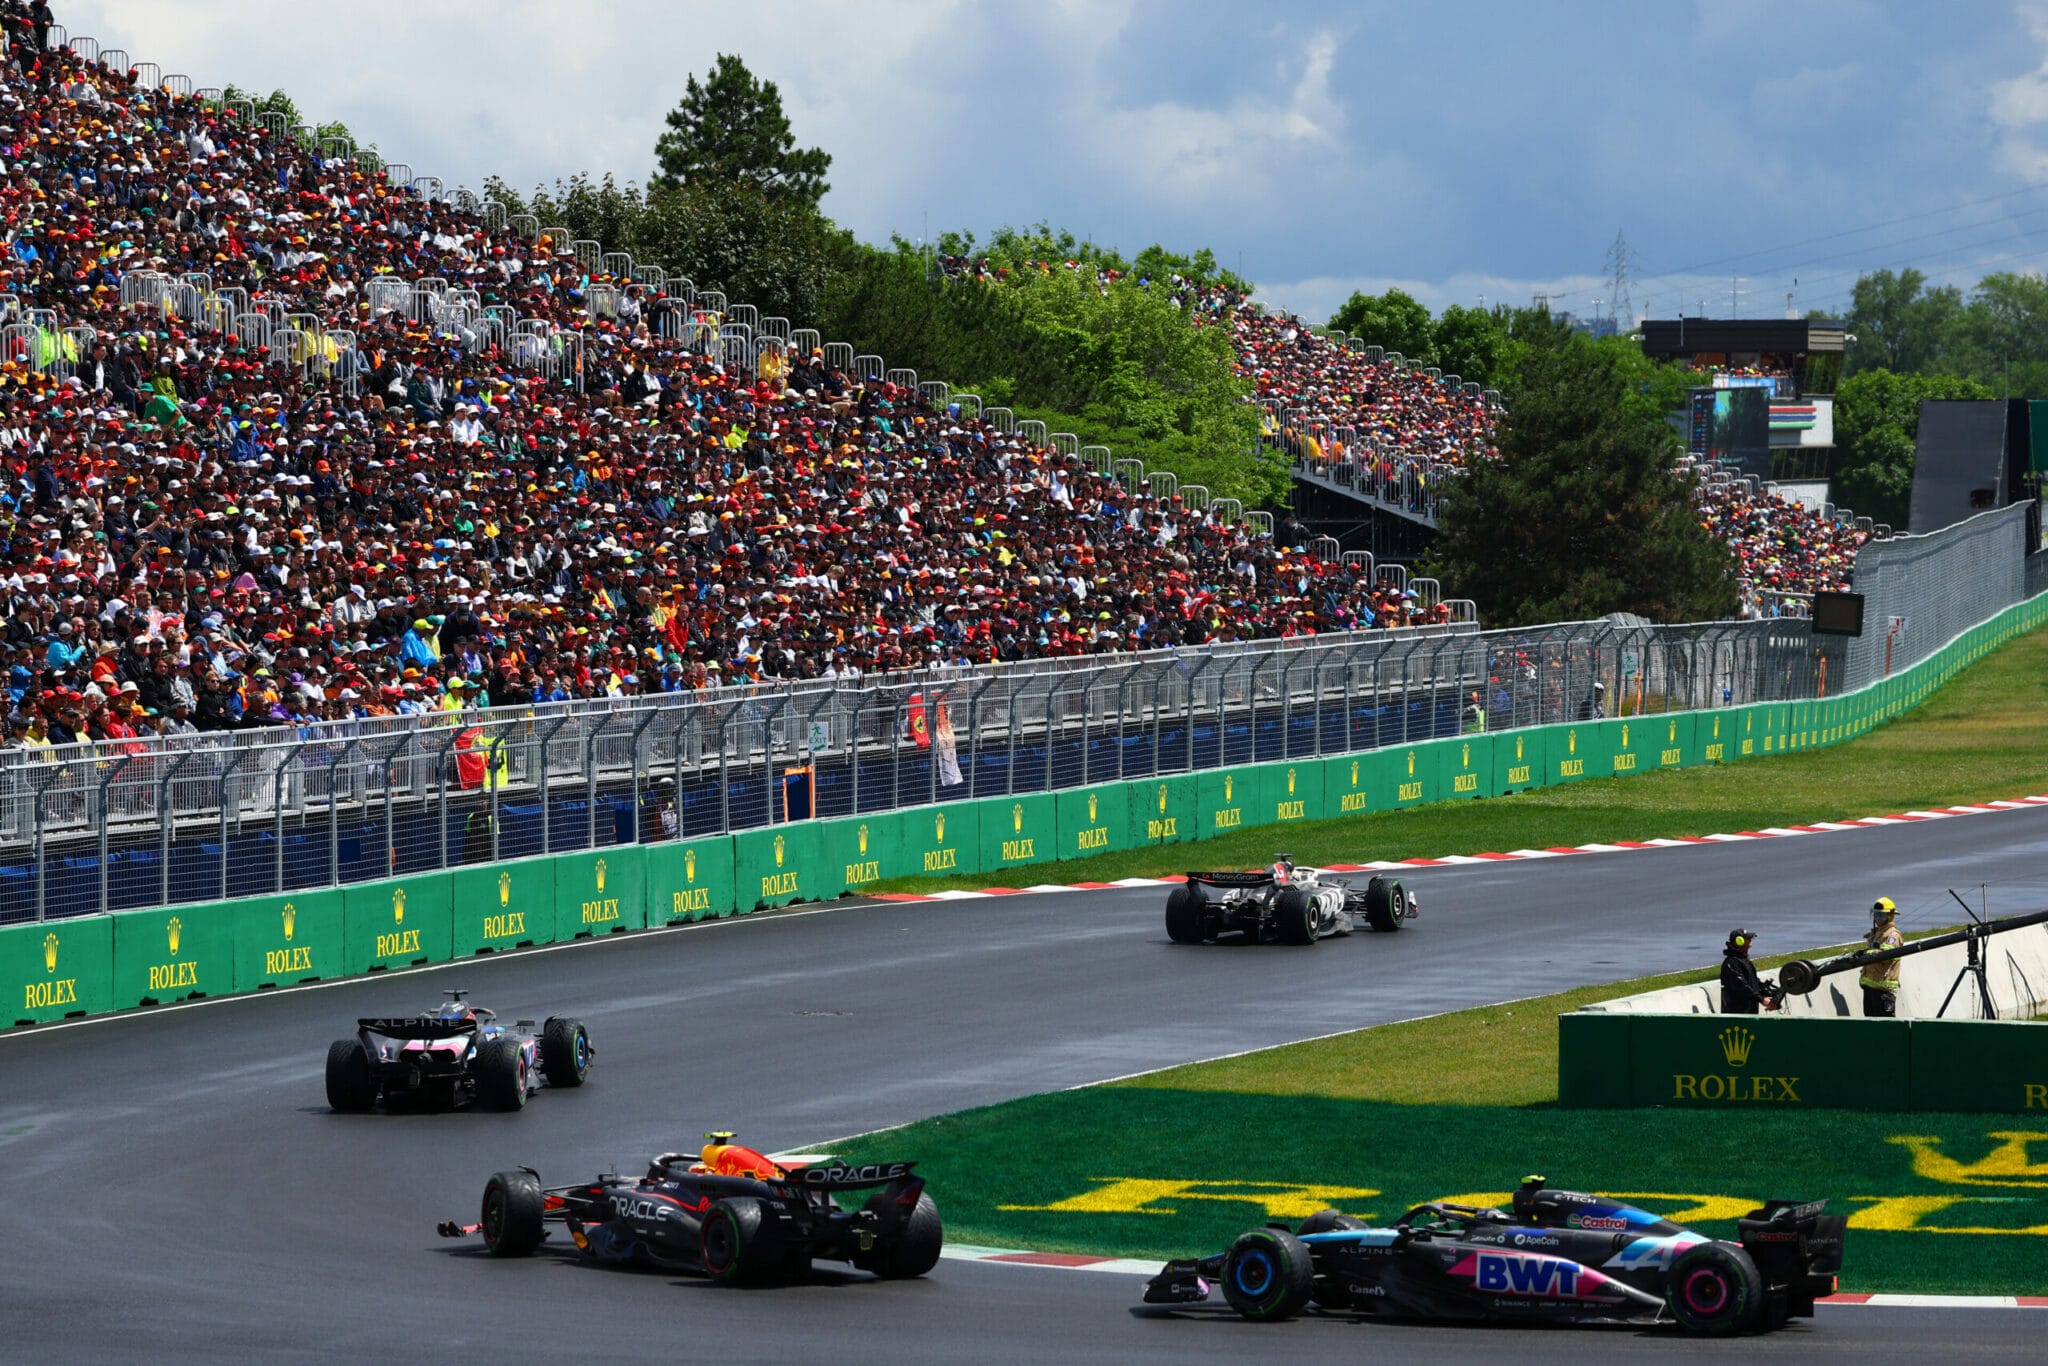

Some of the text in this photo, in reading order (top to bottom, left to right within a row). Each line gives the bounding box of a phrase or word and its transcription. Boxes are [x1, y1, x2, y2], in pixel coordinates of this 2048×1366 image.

[1508, 765, 1530, 784] ROLEX
[1560, 759, 1583, 777] ROLEX
[1398, 781, 1422, 801] ROLEX
[1454, 773, 1477, 792] ROLEX
[1277, 800, 1305, 820] ROLEX
[1341, 791, 1366, 812] ROLEX
[1148, 817, 1177, 839] ROLEX
[1215, 807, 1241, 828] ROLEX
[1078, 827, 1108, 849] ROLEX
[924, 848, 956, 871] ROLEX
[1002, 839, 1035, 860] ROLEX
[846, 861, 880, 884] ROLEX
[1213, 873, 1259, 881] MoneyGram
[762, 872, 798, 897] ROLEX
[582, 898, 619, 923] ROLEX
[673, 888, 709, 913] ROLEX
[484, 912, 525, 939] ROLEX
[377, 929, 420, 958] ROLEX
[266, 946, 312, 974] ROLEX
[149, 961, 198, 990] ROLEX
[25, 979, 77, 1009] ROLEX
[374, 1019, 460, 1027] ALPINE
[1673, 1074, 1801, 1102] ROLEX
[805, 1164, 904, 1183] ORACLE
[608, 1196, 675, 1221] ORACLE
[1581, 1215, 1627, 1230] Castrol
[1339, 1246, 1393, 1256] ALPINE
[1526, 1236, 1559, 1246] ApeCoin
[1477, 1254, 1583, 1296] BWT
